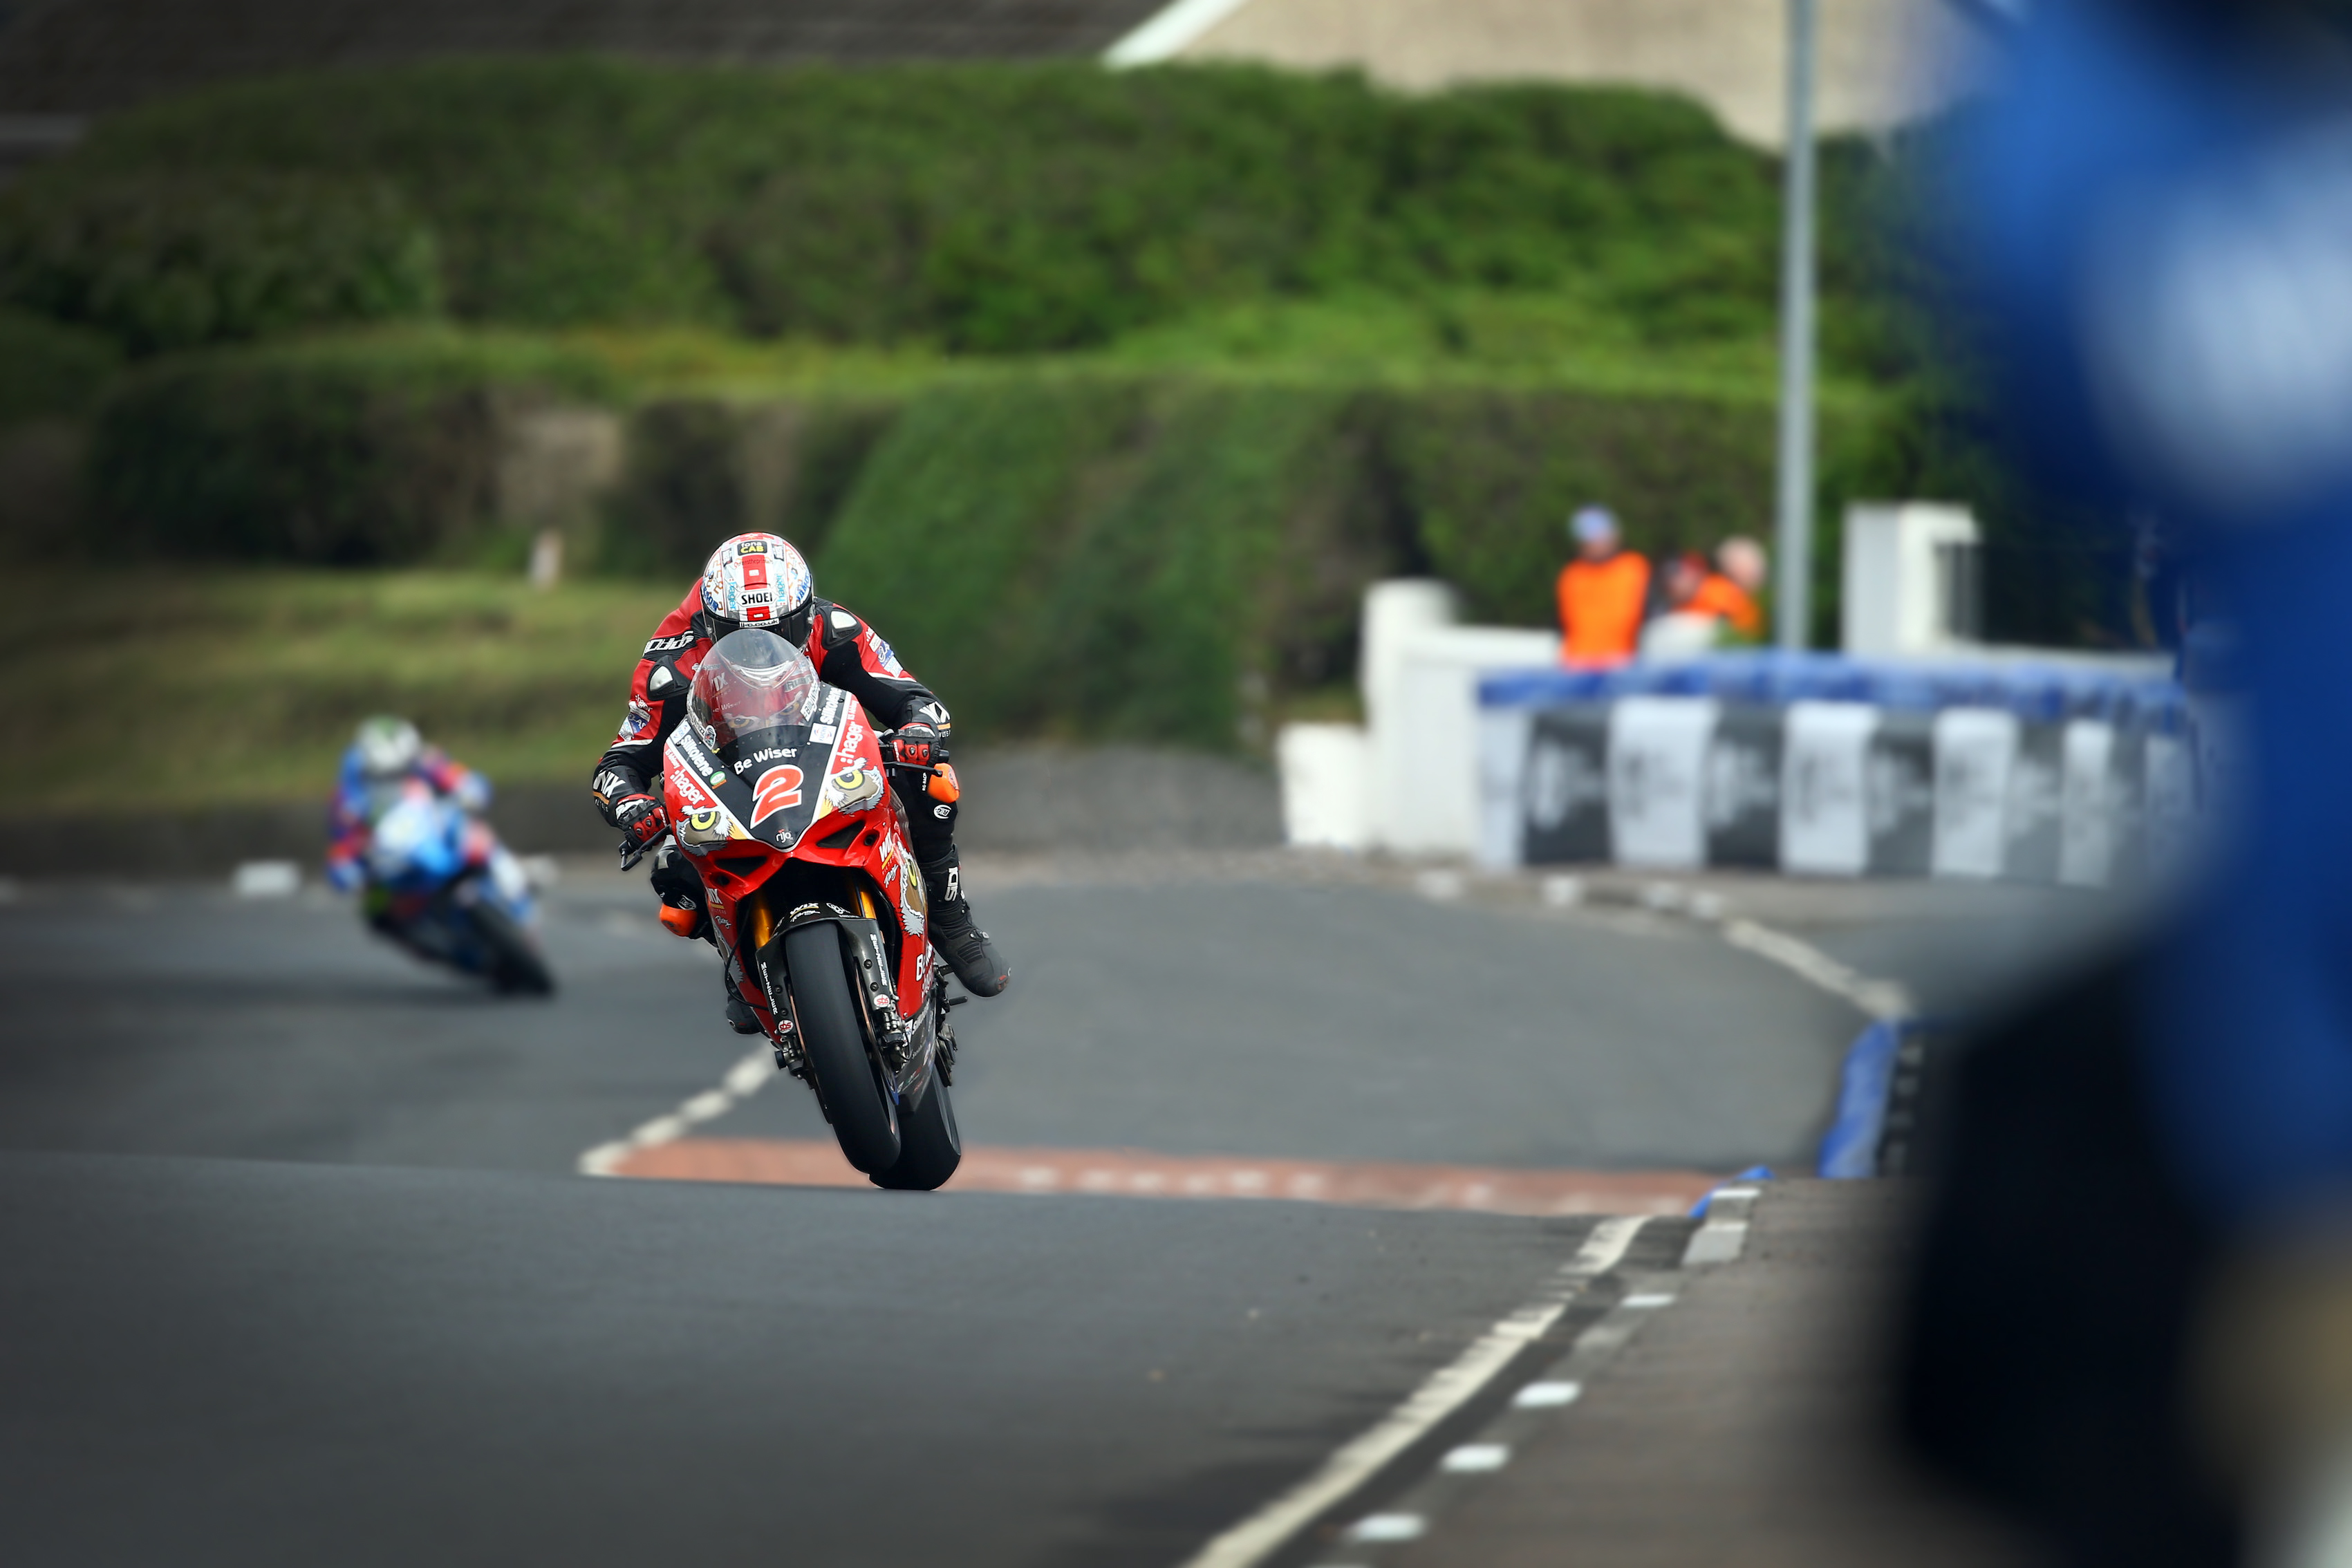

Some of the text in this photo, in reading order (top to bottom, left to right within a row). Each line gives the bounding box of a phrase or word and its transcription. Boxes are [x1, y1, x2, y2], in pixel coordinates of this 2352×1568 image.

[742, 592, 772, 605] SHOEI
[820, 687, 842, 725] Silkolene
[681, 734, 713, 776] Silkolene
[734, 747, 797, 775] Be Wiser
[750, 764, 804, 830] 2
[790, 903, 819, 914] WIX
[870, 933, 888, 987] METZELER
[760, 962, 778, 1016] METZELER
